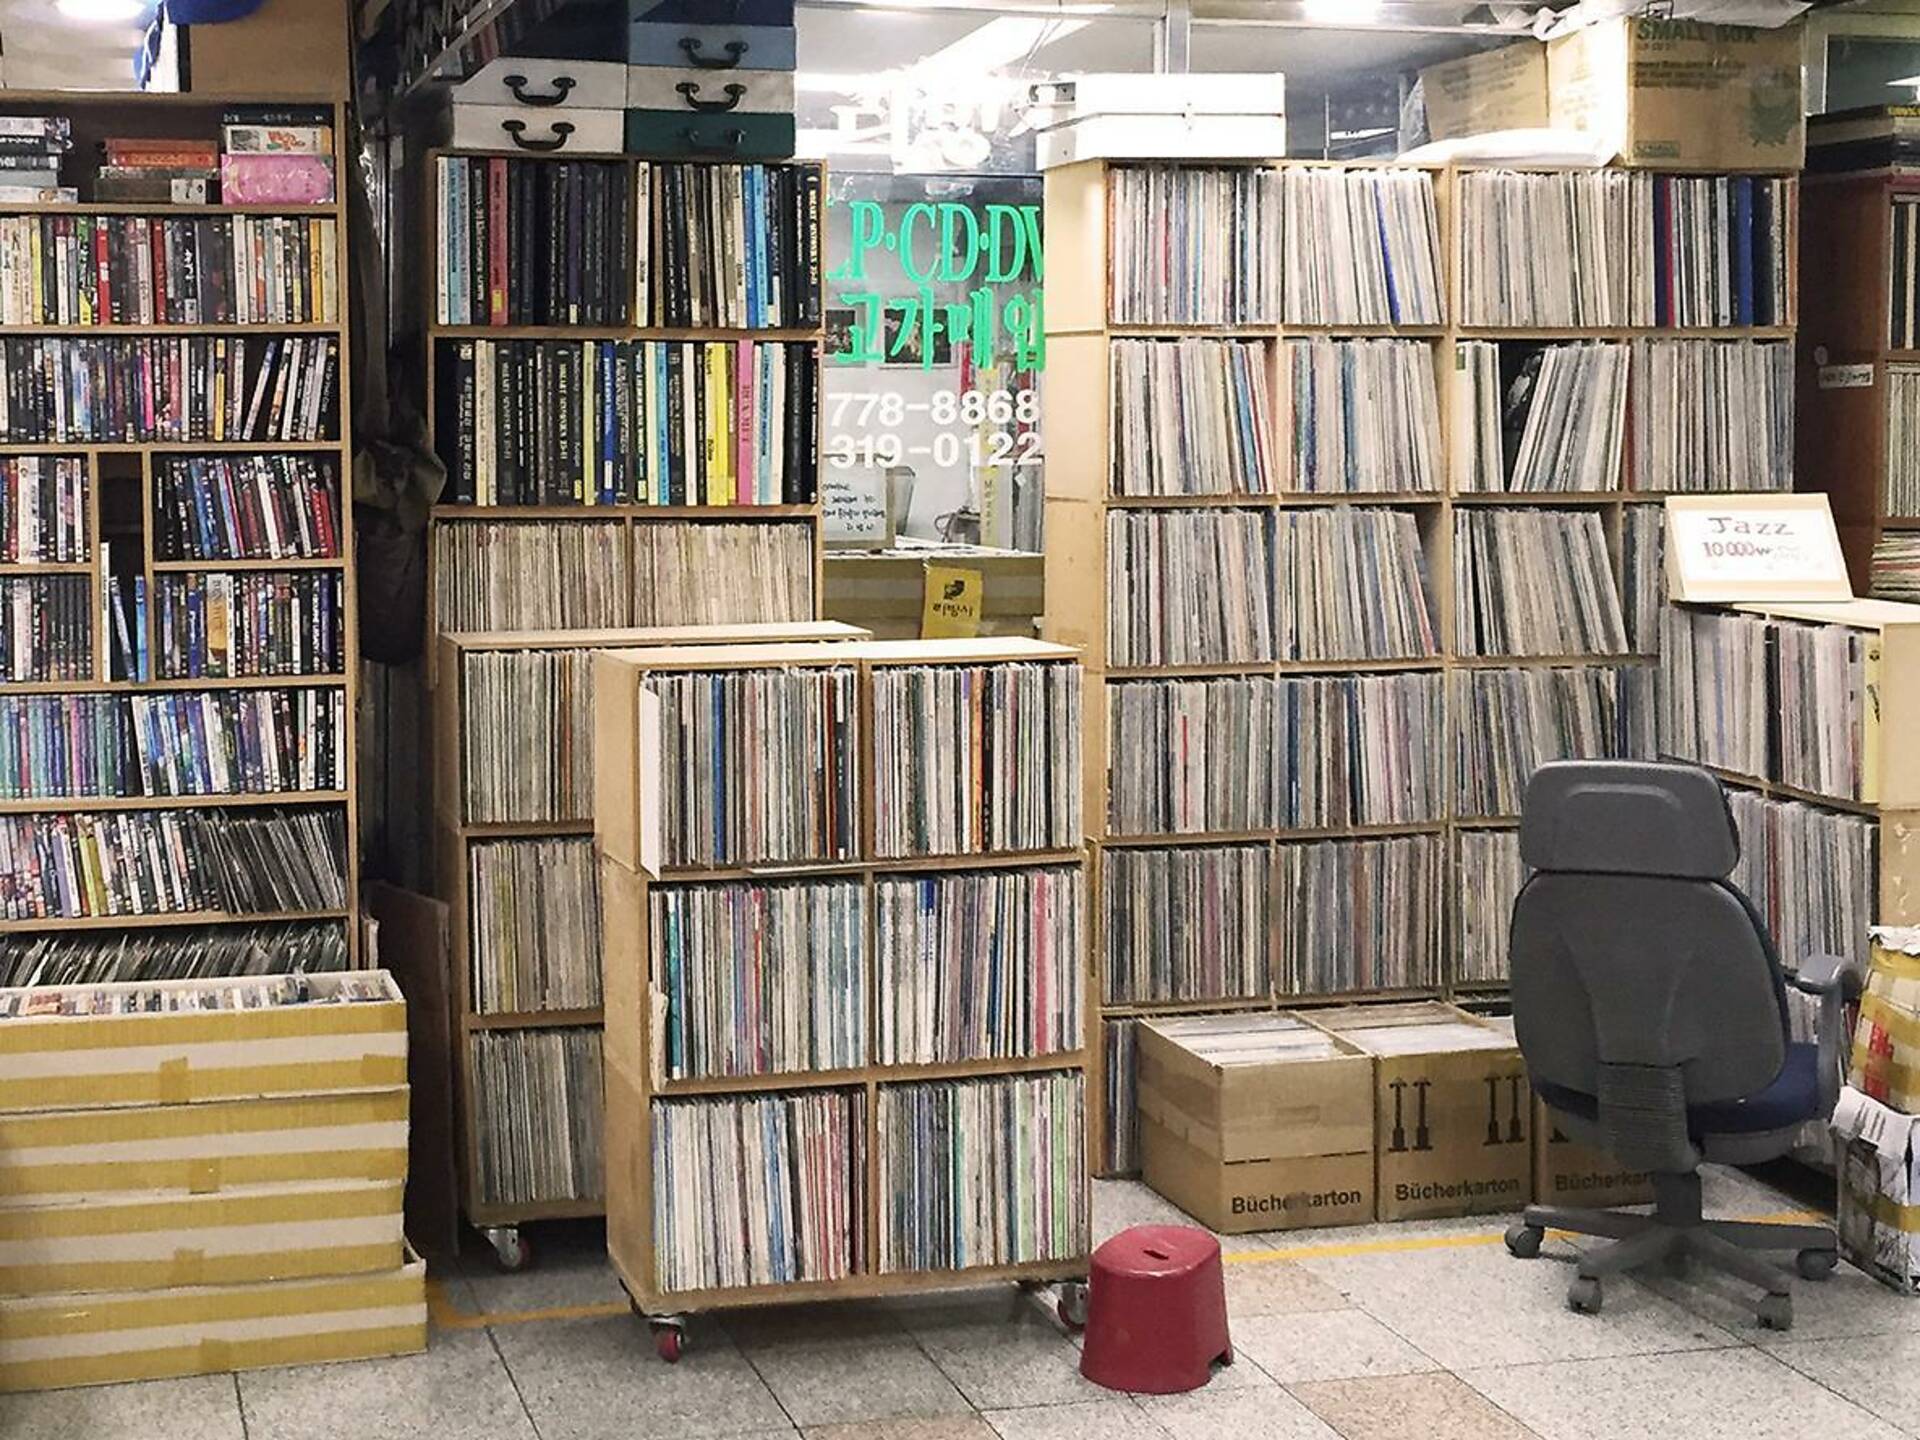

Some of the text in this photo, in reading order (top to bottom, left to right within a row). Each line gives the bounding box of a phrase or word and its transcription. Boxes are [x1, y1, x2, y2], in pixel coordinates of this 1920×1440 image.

[828, 432, 1043, 468] 319-0122
[1707, 516, 1795, 536] Jazz
[1395, 1174, 1520, 1201] Bücherkarton
[1231, 1189, 1362, 1214] Bücharton
